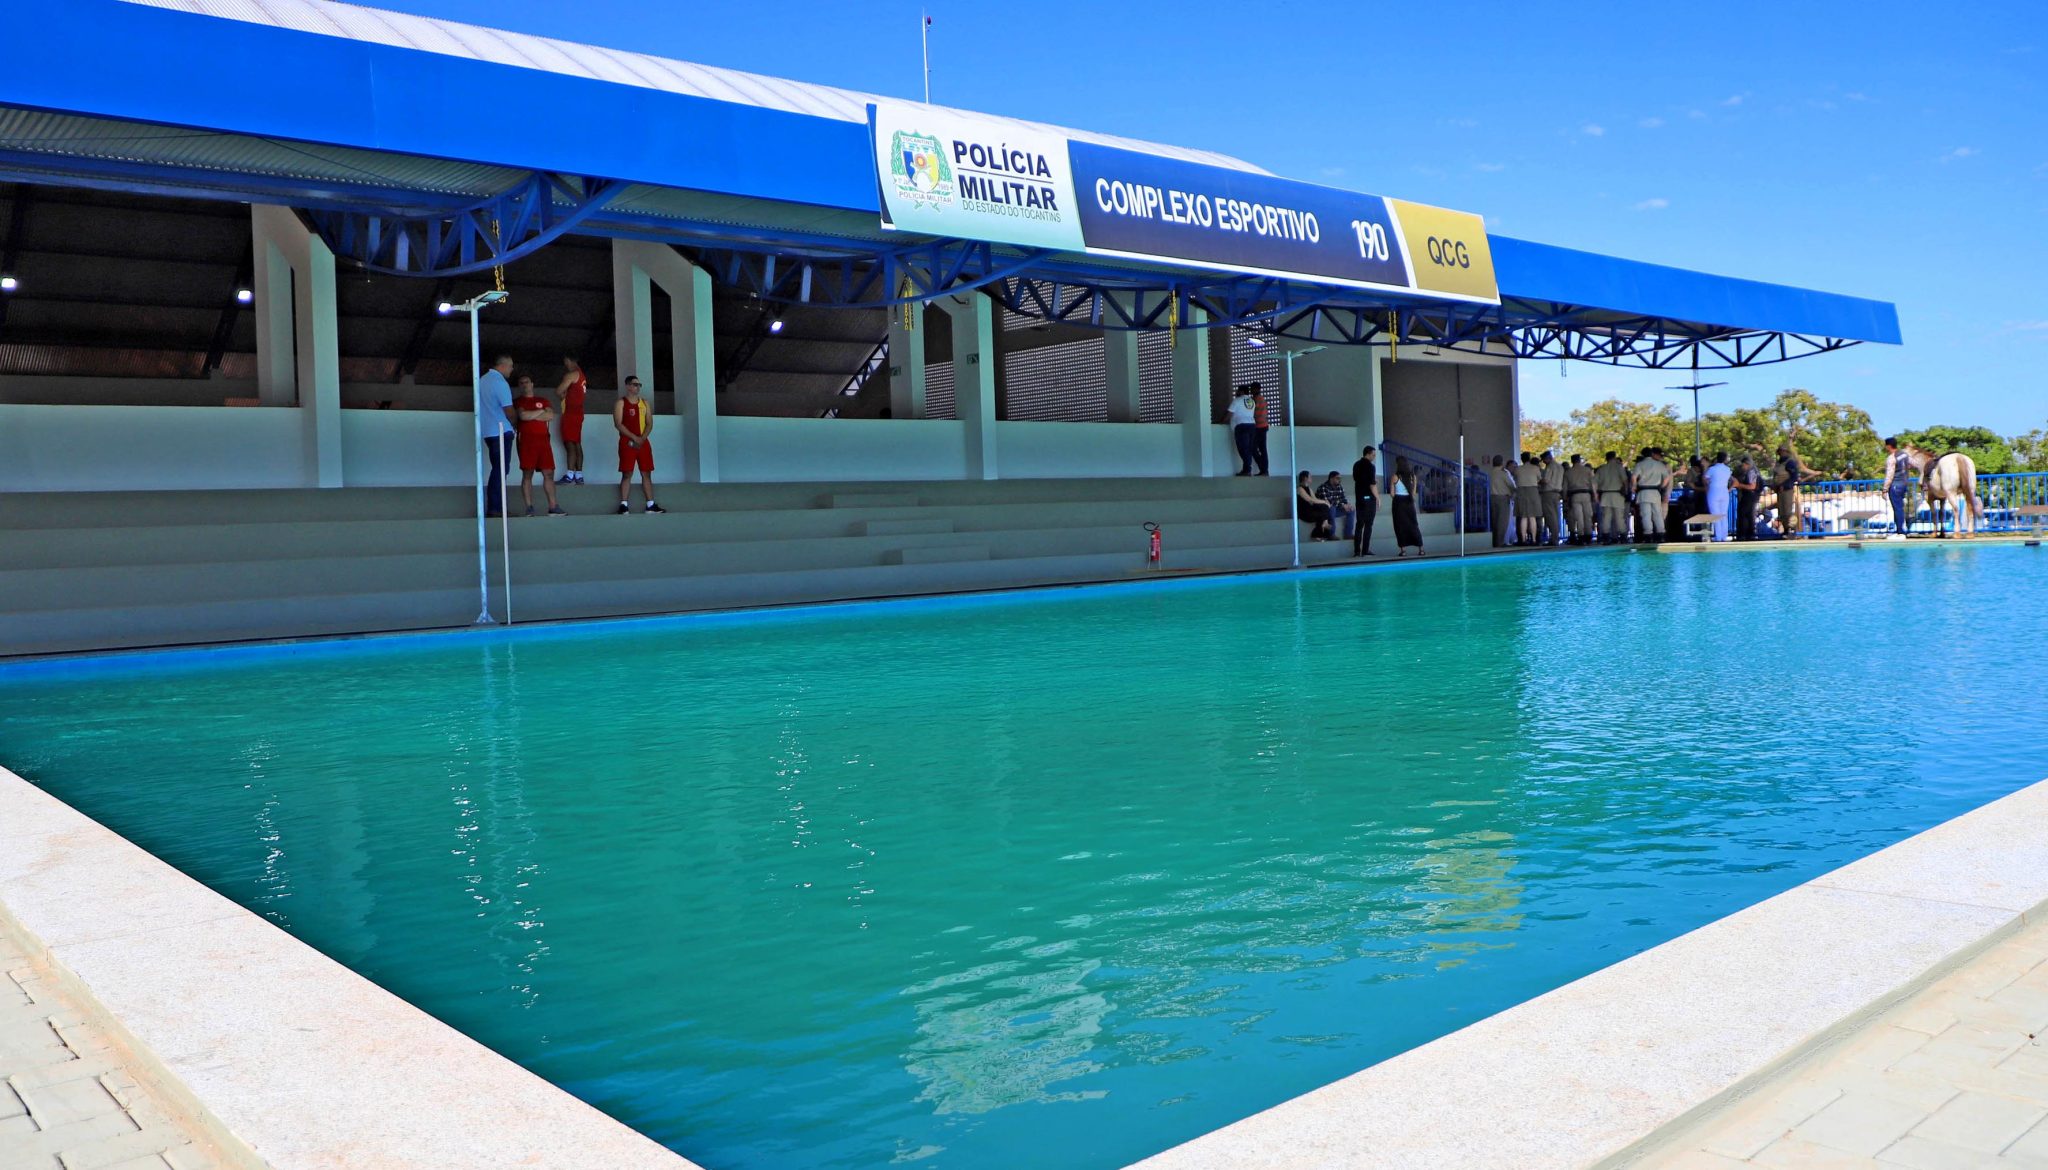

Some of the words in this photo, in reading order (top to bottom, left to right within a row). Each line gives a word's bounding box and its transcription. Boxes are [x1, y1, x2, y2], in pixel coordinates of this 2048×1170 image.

[953, 140, 1052, 178] POLÍCIA
[958, 174, 1058, 211] MILITAR
[1095, 177, 1213, 228] COMPLEXO
[1215, 197, 1320, 243] ESPORTIVO
[962, 200, 975, 212] DO
[976, 202, 1006, 216] ESTADO
[1007, 205, 1019, 218] DO
[1020, 207, 1061, 223] TOCANTINS
[1351, 220, 1389, 261] 190
[1427, 236, 1470, 268] QCG
